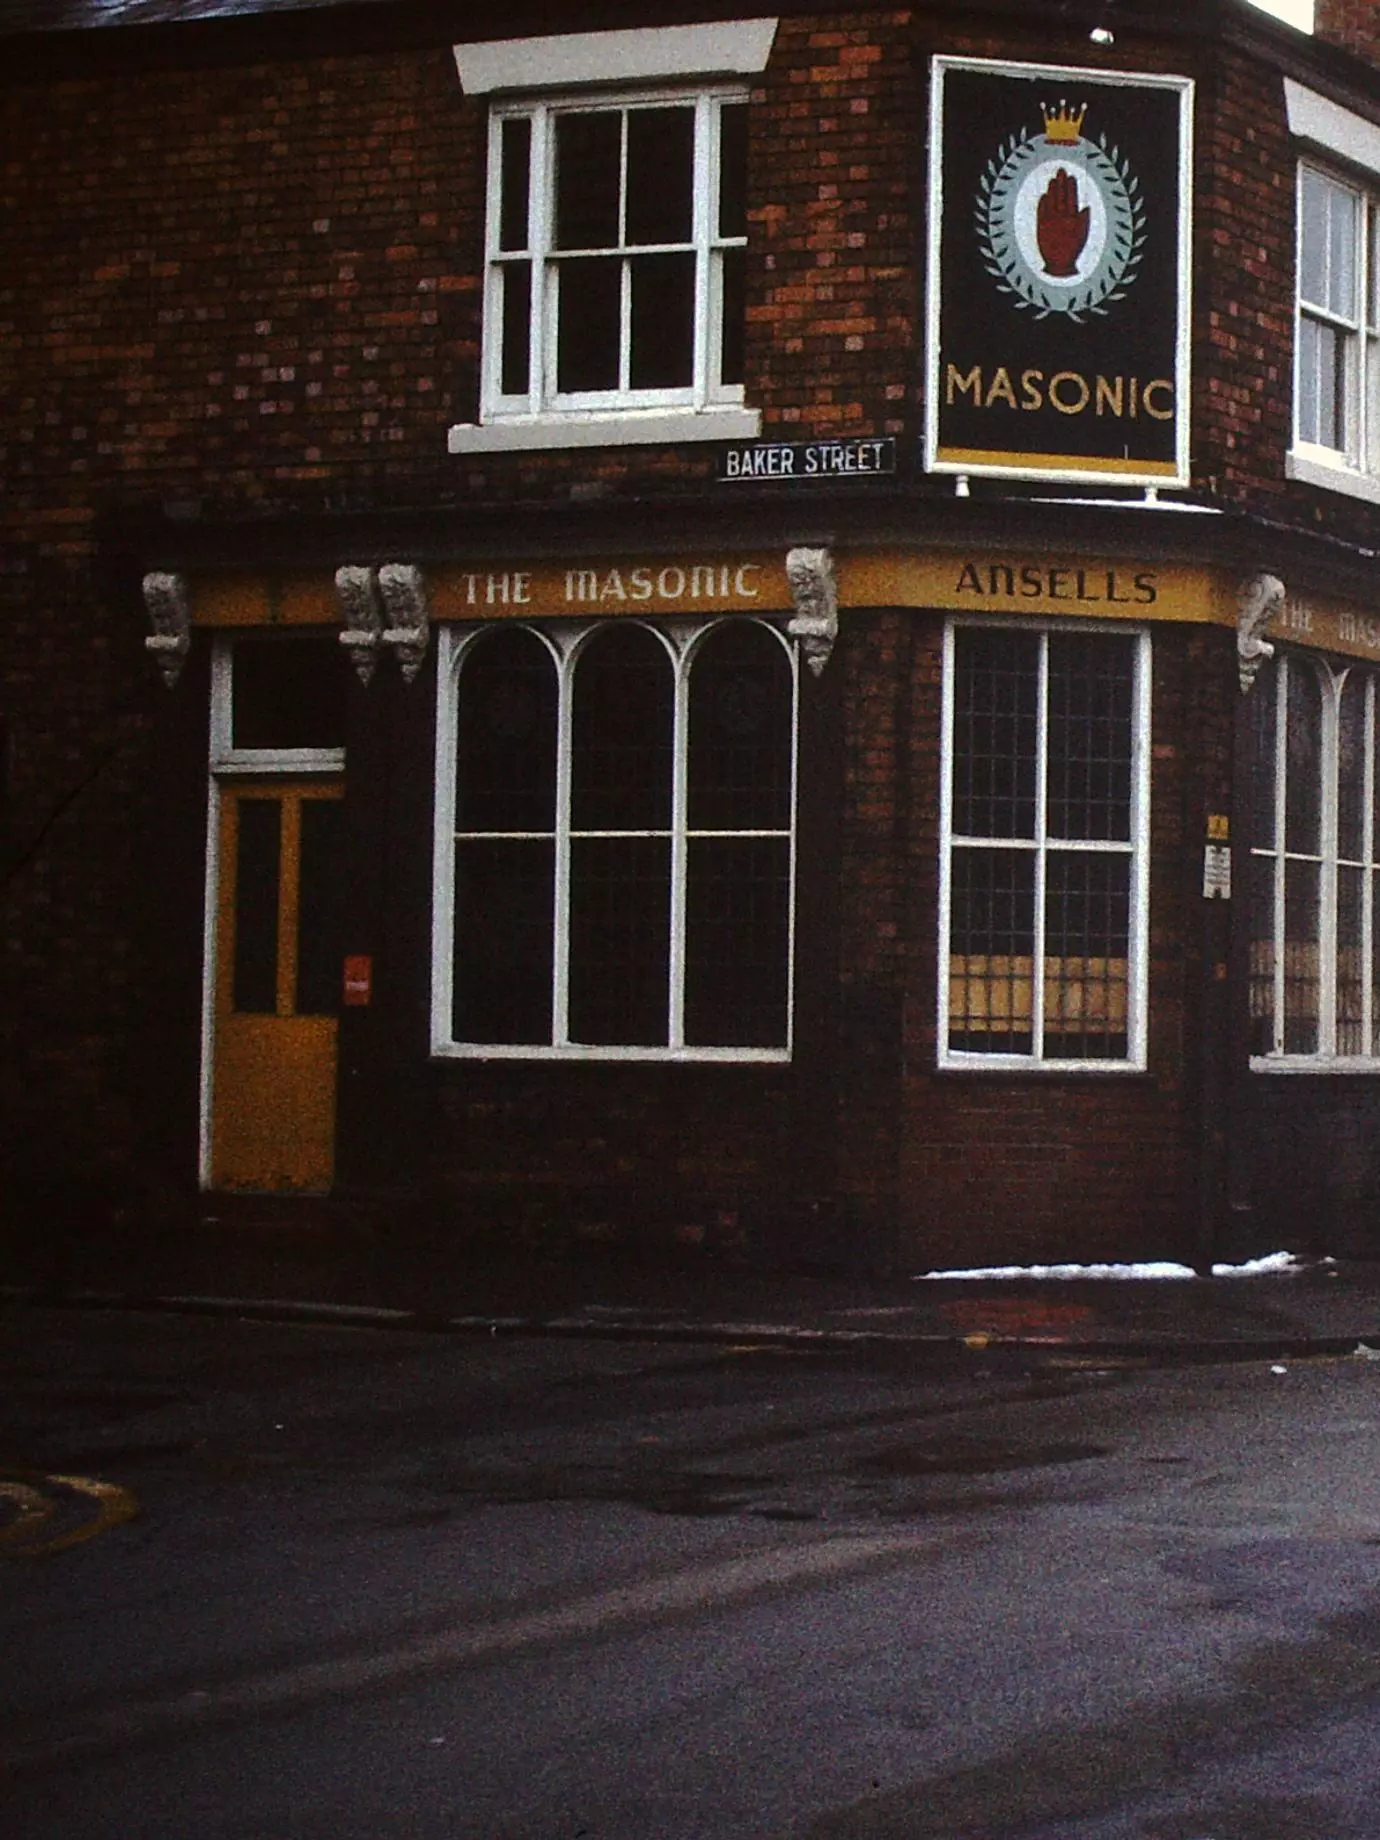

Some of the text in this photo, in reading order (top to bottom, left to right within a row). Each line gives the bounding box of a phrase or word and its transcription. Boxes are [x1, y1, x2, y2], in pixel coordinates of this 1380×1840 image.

[946, 363, 1175, 420] MASONIC
[726, 442, 884, 477] BAKER STREET
[462, 564, 762, 605] THE MASONIC
[955, 563, 1158, 604] ANSELLS
[1280, 600, 1314, 632] THE
